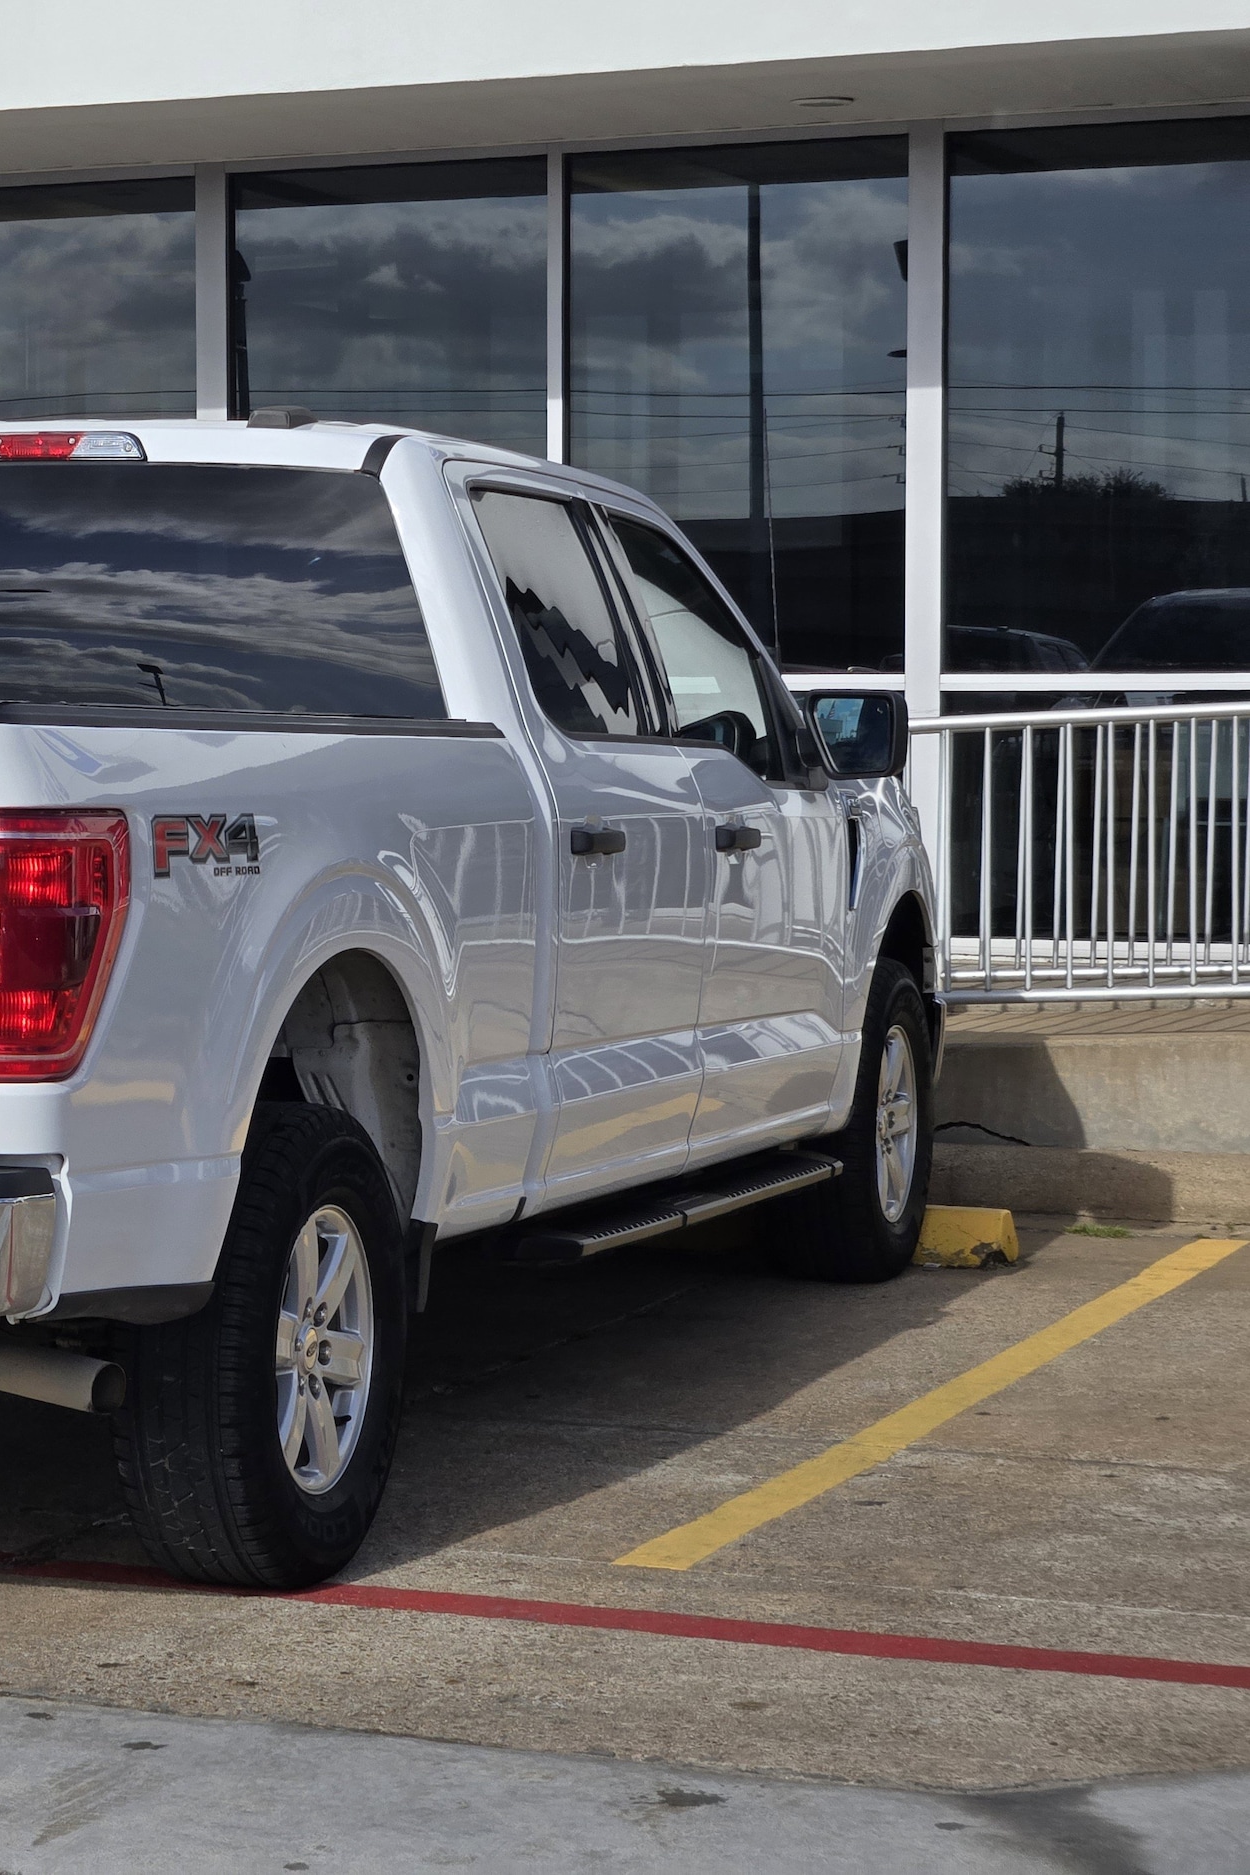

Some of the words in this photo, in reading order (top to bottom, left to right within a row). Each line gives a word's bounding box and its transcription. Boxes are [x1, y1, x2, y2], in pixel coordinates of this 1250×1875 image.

[151, 813, 259, 879] FX4
[213, 866, 232, 877] OFF
[235, 866, 260, 876] ROAD
